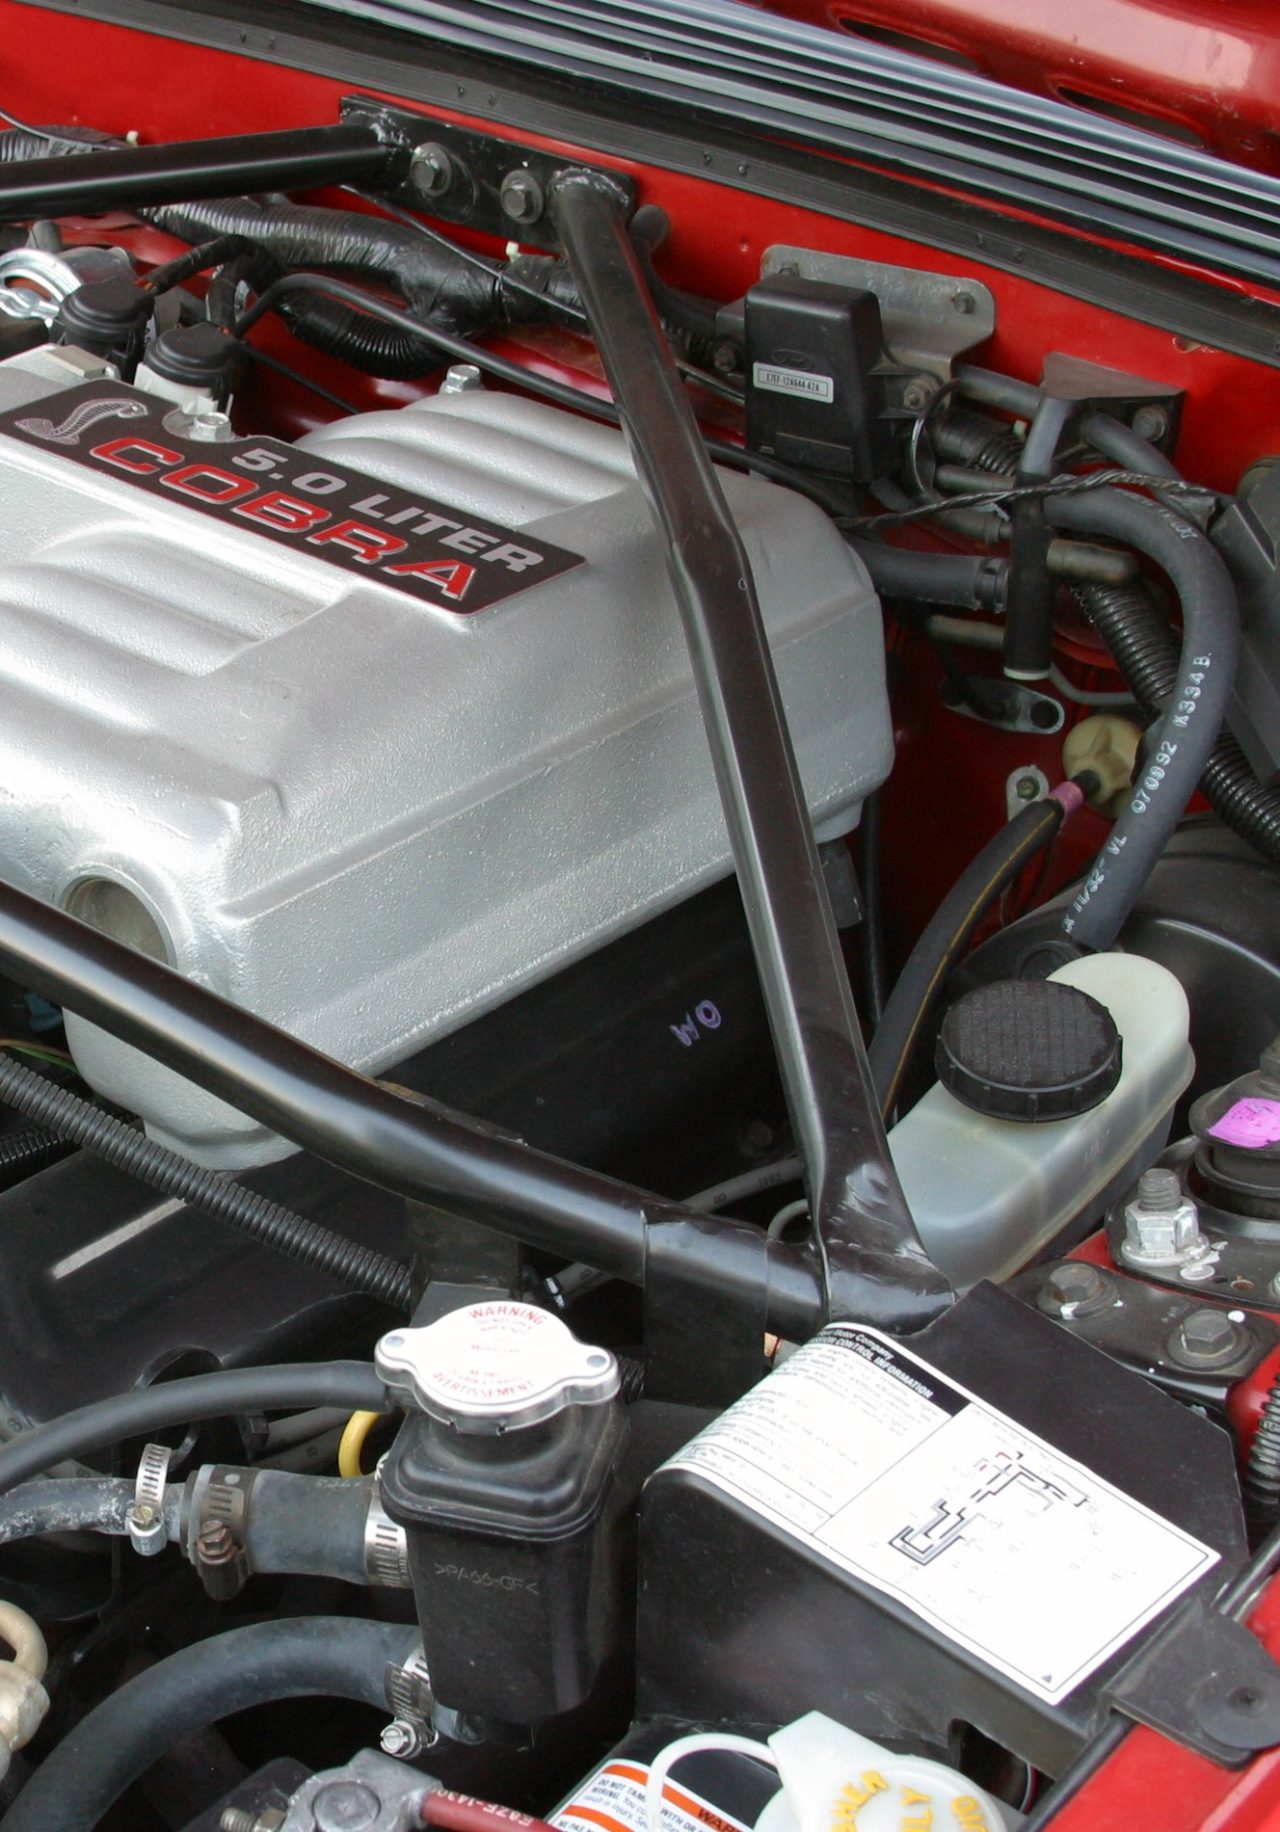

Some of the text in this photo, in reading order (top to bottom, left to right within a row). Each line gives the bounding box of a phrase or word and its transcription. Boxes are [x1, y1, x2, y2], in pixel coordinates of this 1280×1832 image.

[89, 435, 477, 601] COBRA
[231, 448, 545, 574] 5.0 LITER
[467, 1305, 548, 1326] WARNING
[855, 1333, 895, 1361] Company
[834, 1337, 875, 1363] CONTROL
[873, 1356, 934, 1399] INFORMATION
[432, 1371, 535, 1398] AVERTISSEMENT
[660, 1806, 683, 1826] WITH
